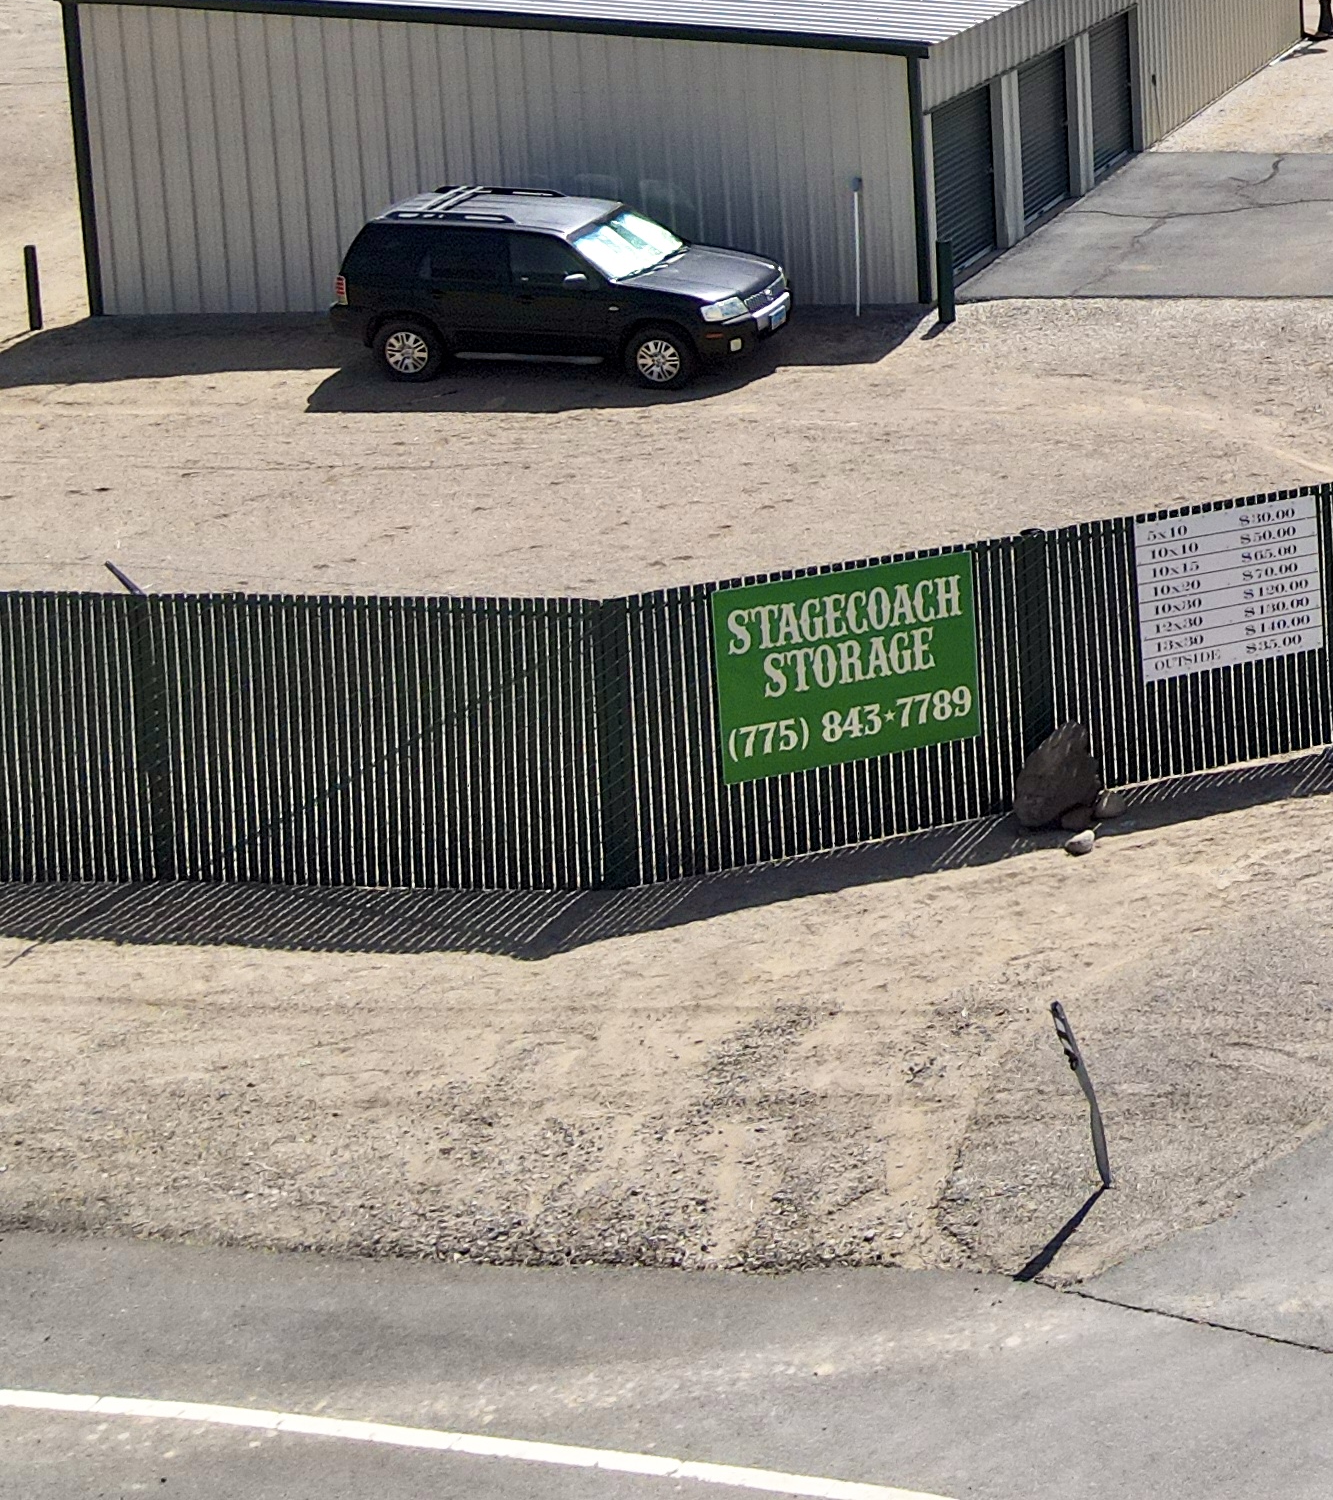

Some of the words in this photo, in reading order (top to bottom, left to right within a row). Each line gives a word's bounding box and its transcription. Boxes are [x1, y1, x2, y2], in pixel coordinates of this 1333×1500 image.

[1147, 525, 1188, 542] 5x10
[1151, 542, 1199, 560] 10x10
[1152, 561, 1200, 578] 10x15
[1153, 579, 1201, 597] 10x20
[727, 574, 963, 656] STAGECOACH
[1154, 597, 1202, 615] 10x30
[763, 626, 936, 698] STORAGE
[1155, 649, 1221, 671] OUTSIDE
[728, 717, 810, 763] (775)
